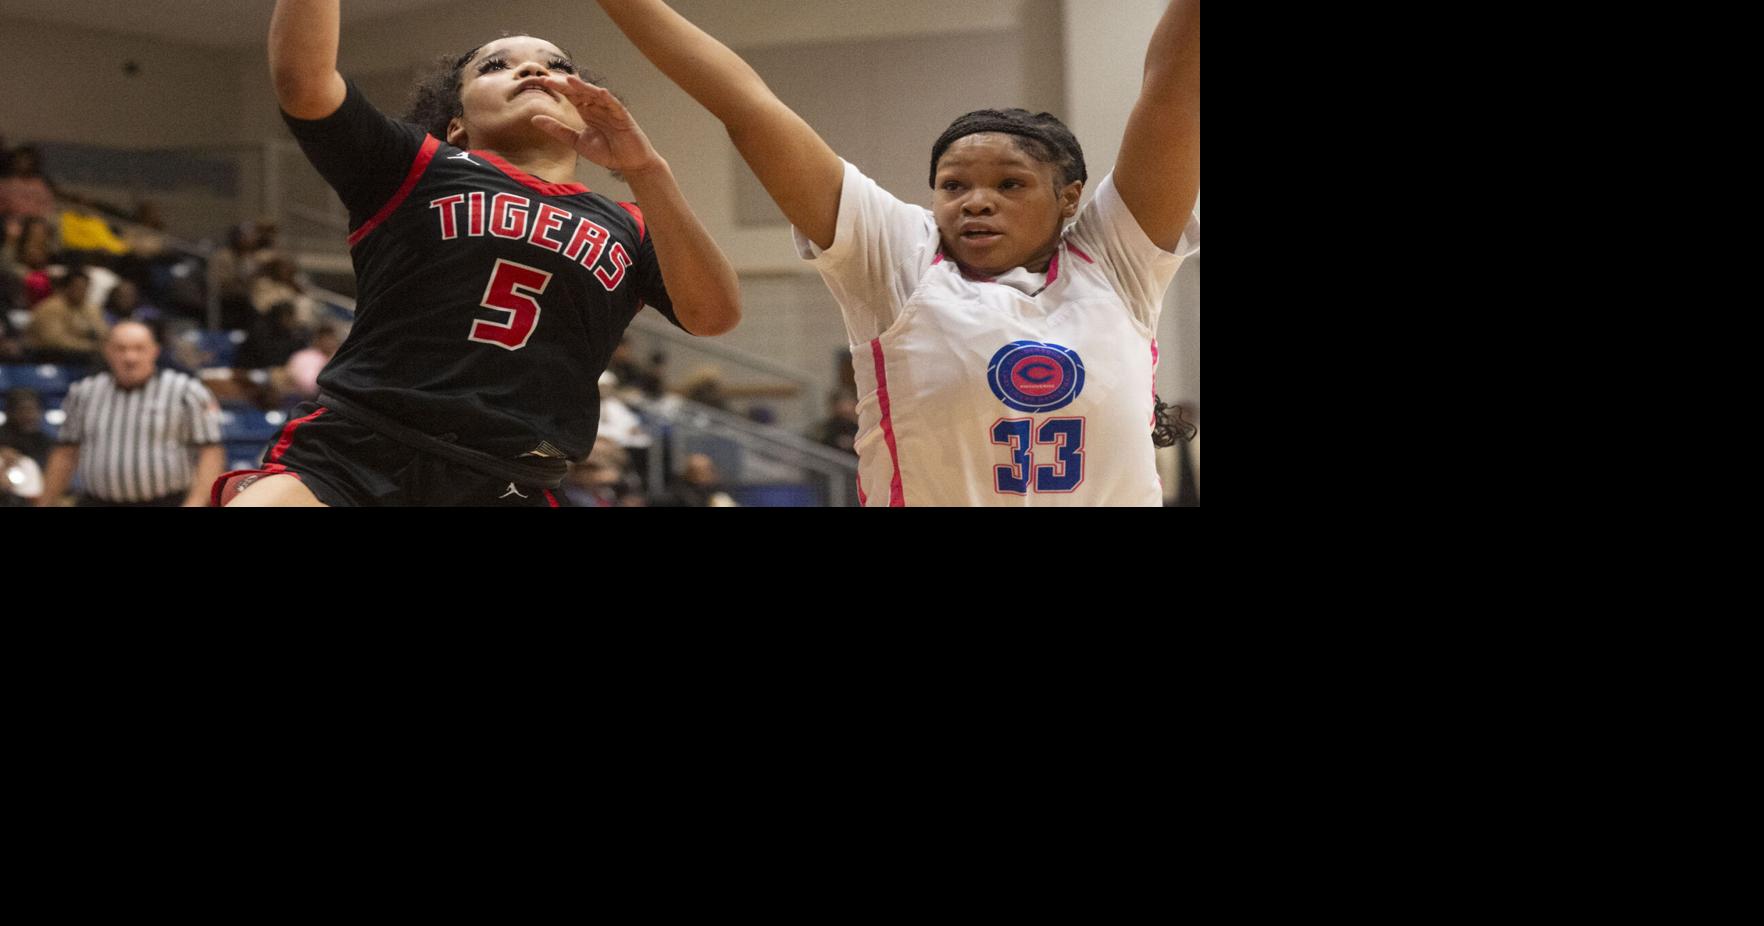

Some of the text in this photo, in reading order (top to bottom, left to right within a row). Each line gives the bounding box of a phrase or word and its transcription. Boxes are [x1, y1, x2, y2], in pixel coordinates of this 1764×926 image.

[429, 191, 633, 291] TIGERS
[467, 257, 554, 351] 5
[1016, 362, 1056, 385] C
[989, 416, 1086, 496] 33
